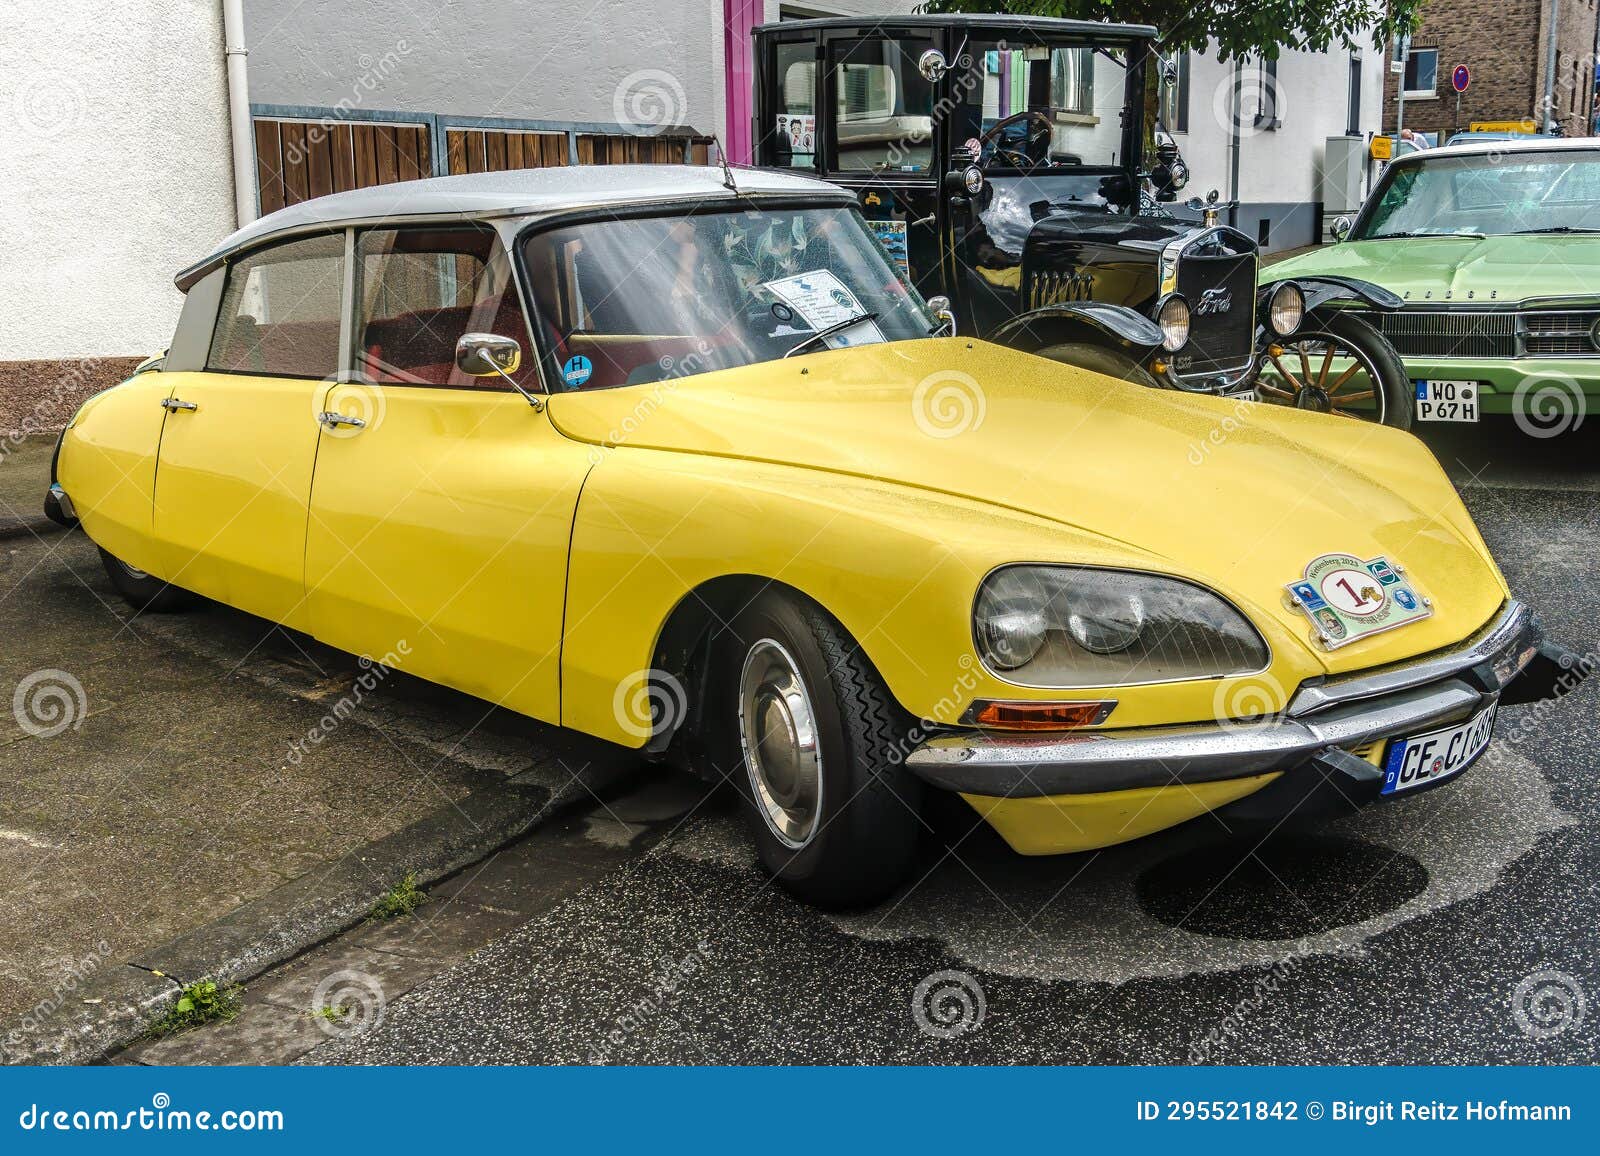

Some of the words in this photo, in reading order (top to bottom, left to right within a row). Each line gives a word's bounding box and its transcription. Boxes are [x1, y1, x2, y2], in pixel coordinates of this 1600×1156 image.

[1197, 286, 1233, 316] Ford
[571, 356, 583, 371] H
[1432, 382, 1456, 401] WO
[1335, 577, 1369, 608] 1
[1400, 739, 1438, 783] CE
